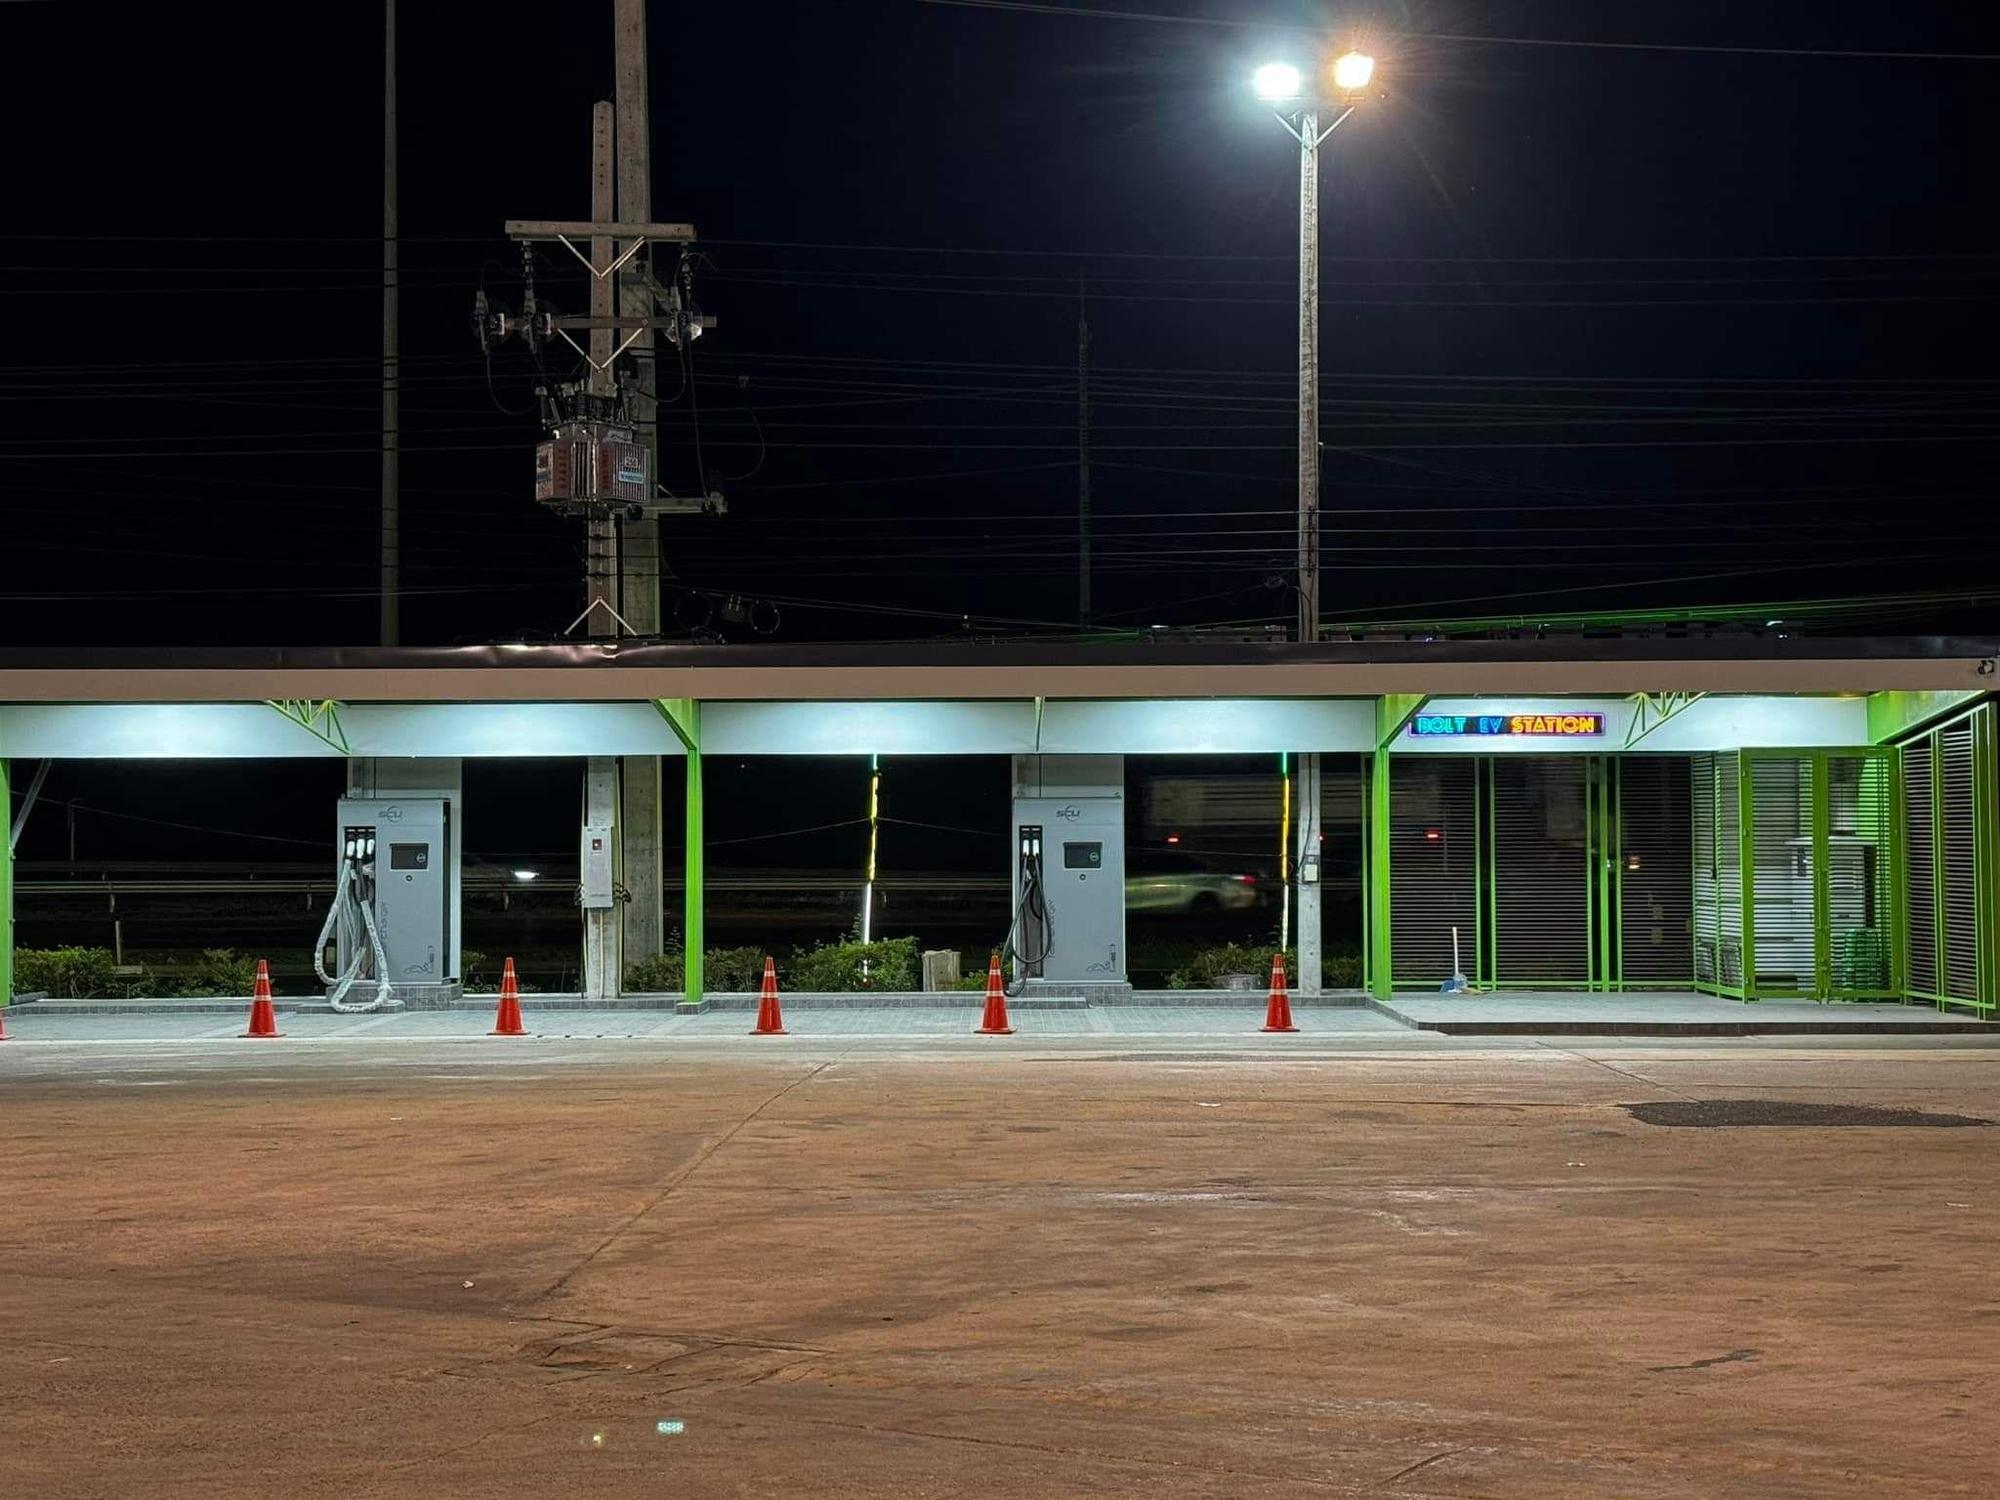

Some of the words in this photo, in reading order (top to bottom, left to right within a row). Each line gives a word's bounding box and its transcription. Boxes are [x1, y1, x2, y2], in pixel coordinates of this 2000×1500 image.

[1418, 717, 1466, 733] BOLT
[1479, 717, 1503, 733] EV
[1511, 716, 1594, 733] STATION
